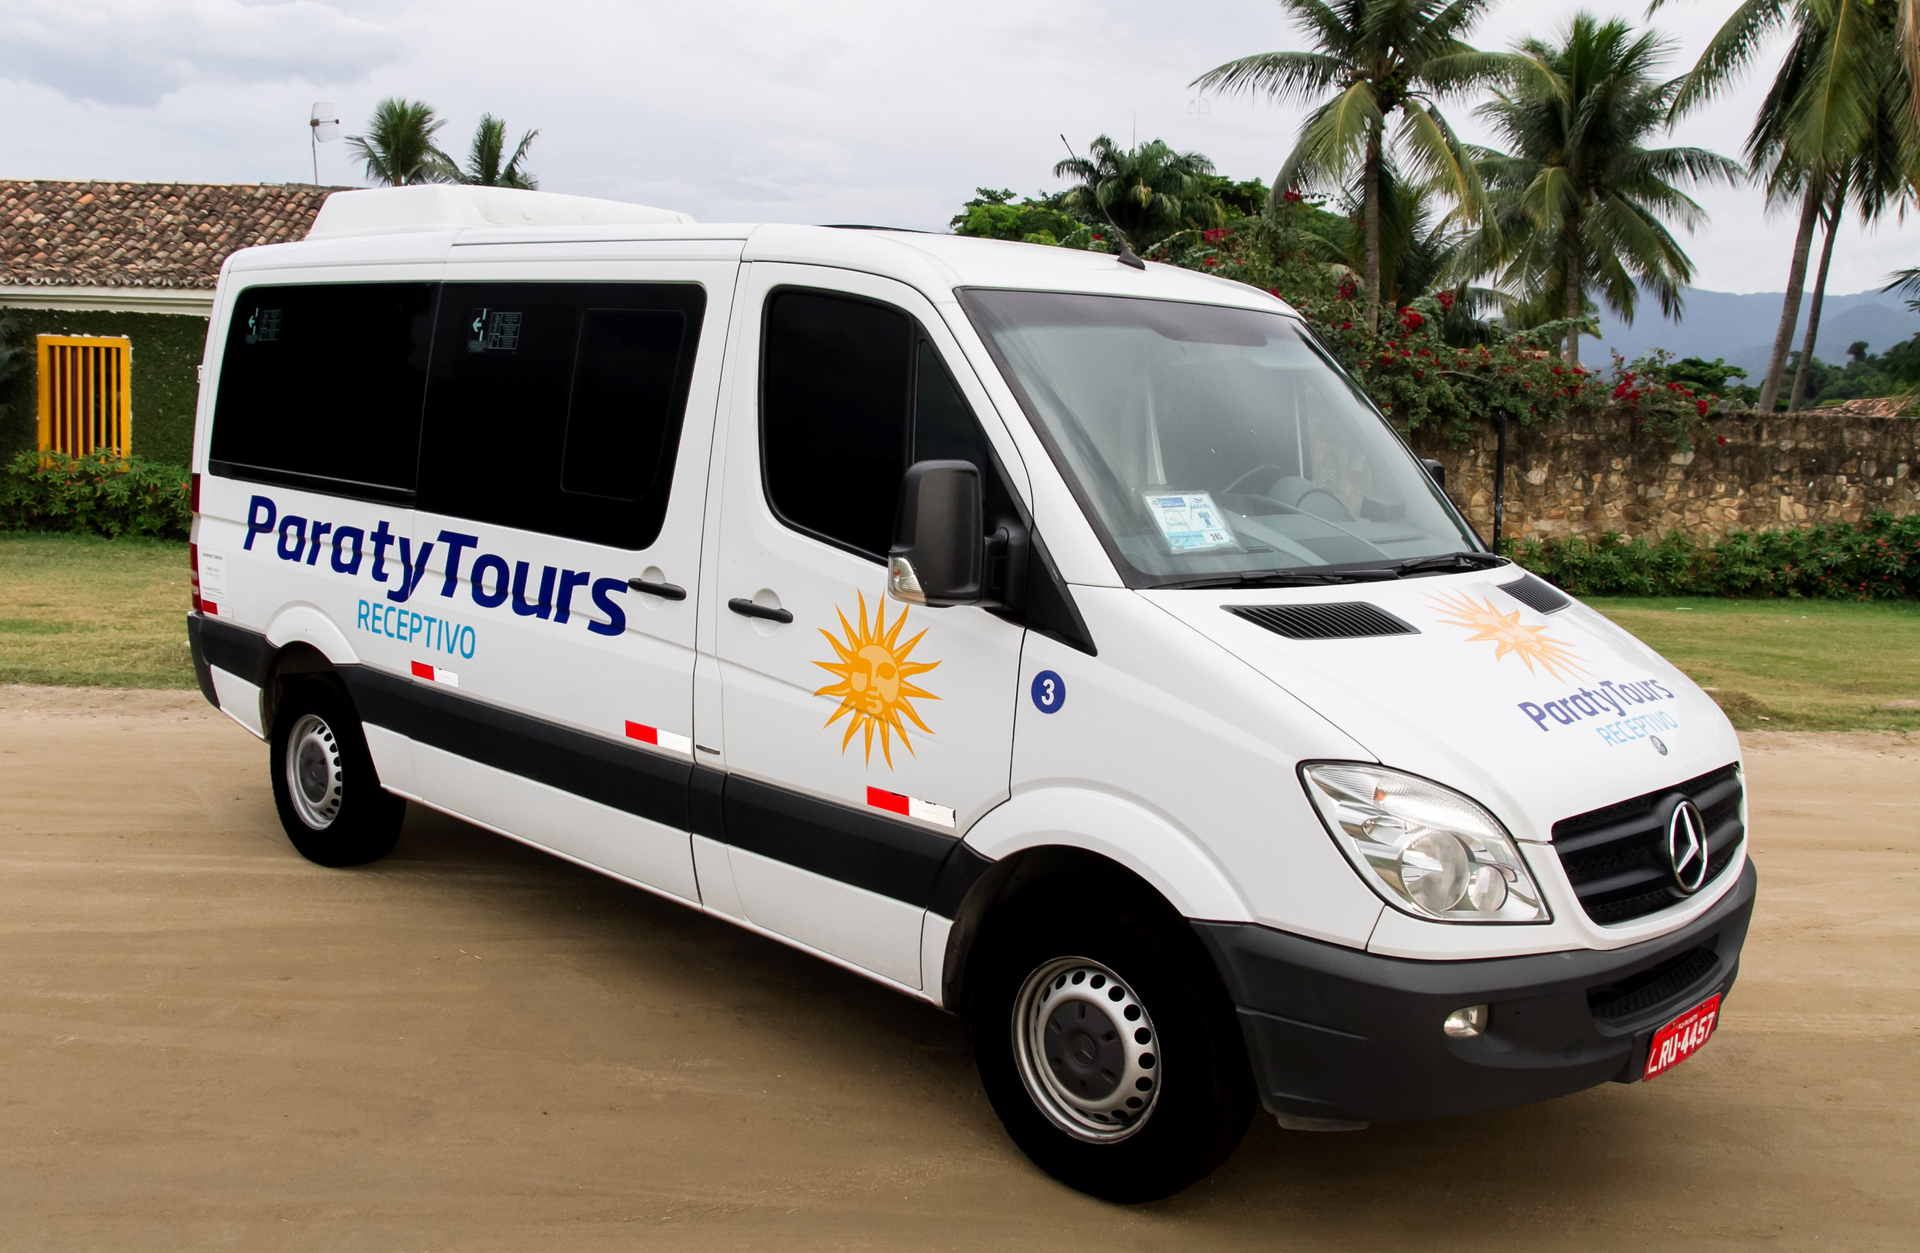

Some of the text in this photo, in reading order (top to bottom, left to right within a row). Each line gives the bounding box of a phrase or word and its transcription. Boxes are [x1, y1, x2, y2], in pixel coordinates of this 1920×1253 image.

[243, 495, 629, 636] ParatyTours
[357, 599, 476, 659] RECEPTIVO
[1041, 678, 1055, 706] 3
[1518, 680, 1674, 732] ParatyTours
[1596, 711, 1678, 747] RECEPTIVO
